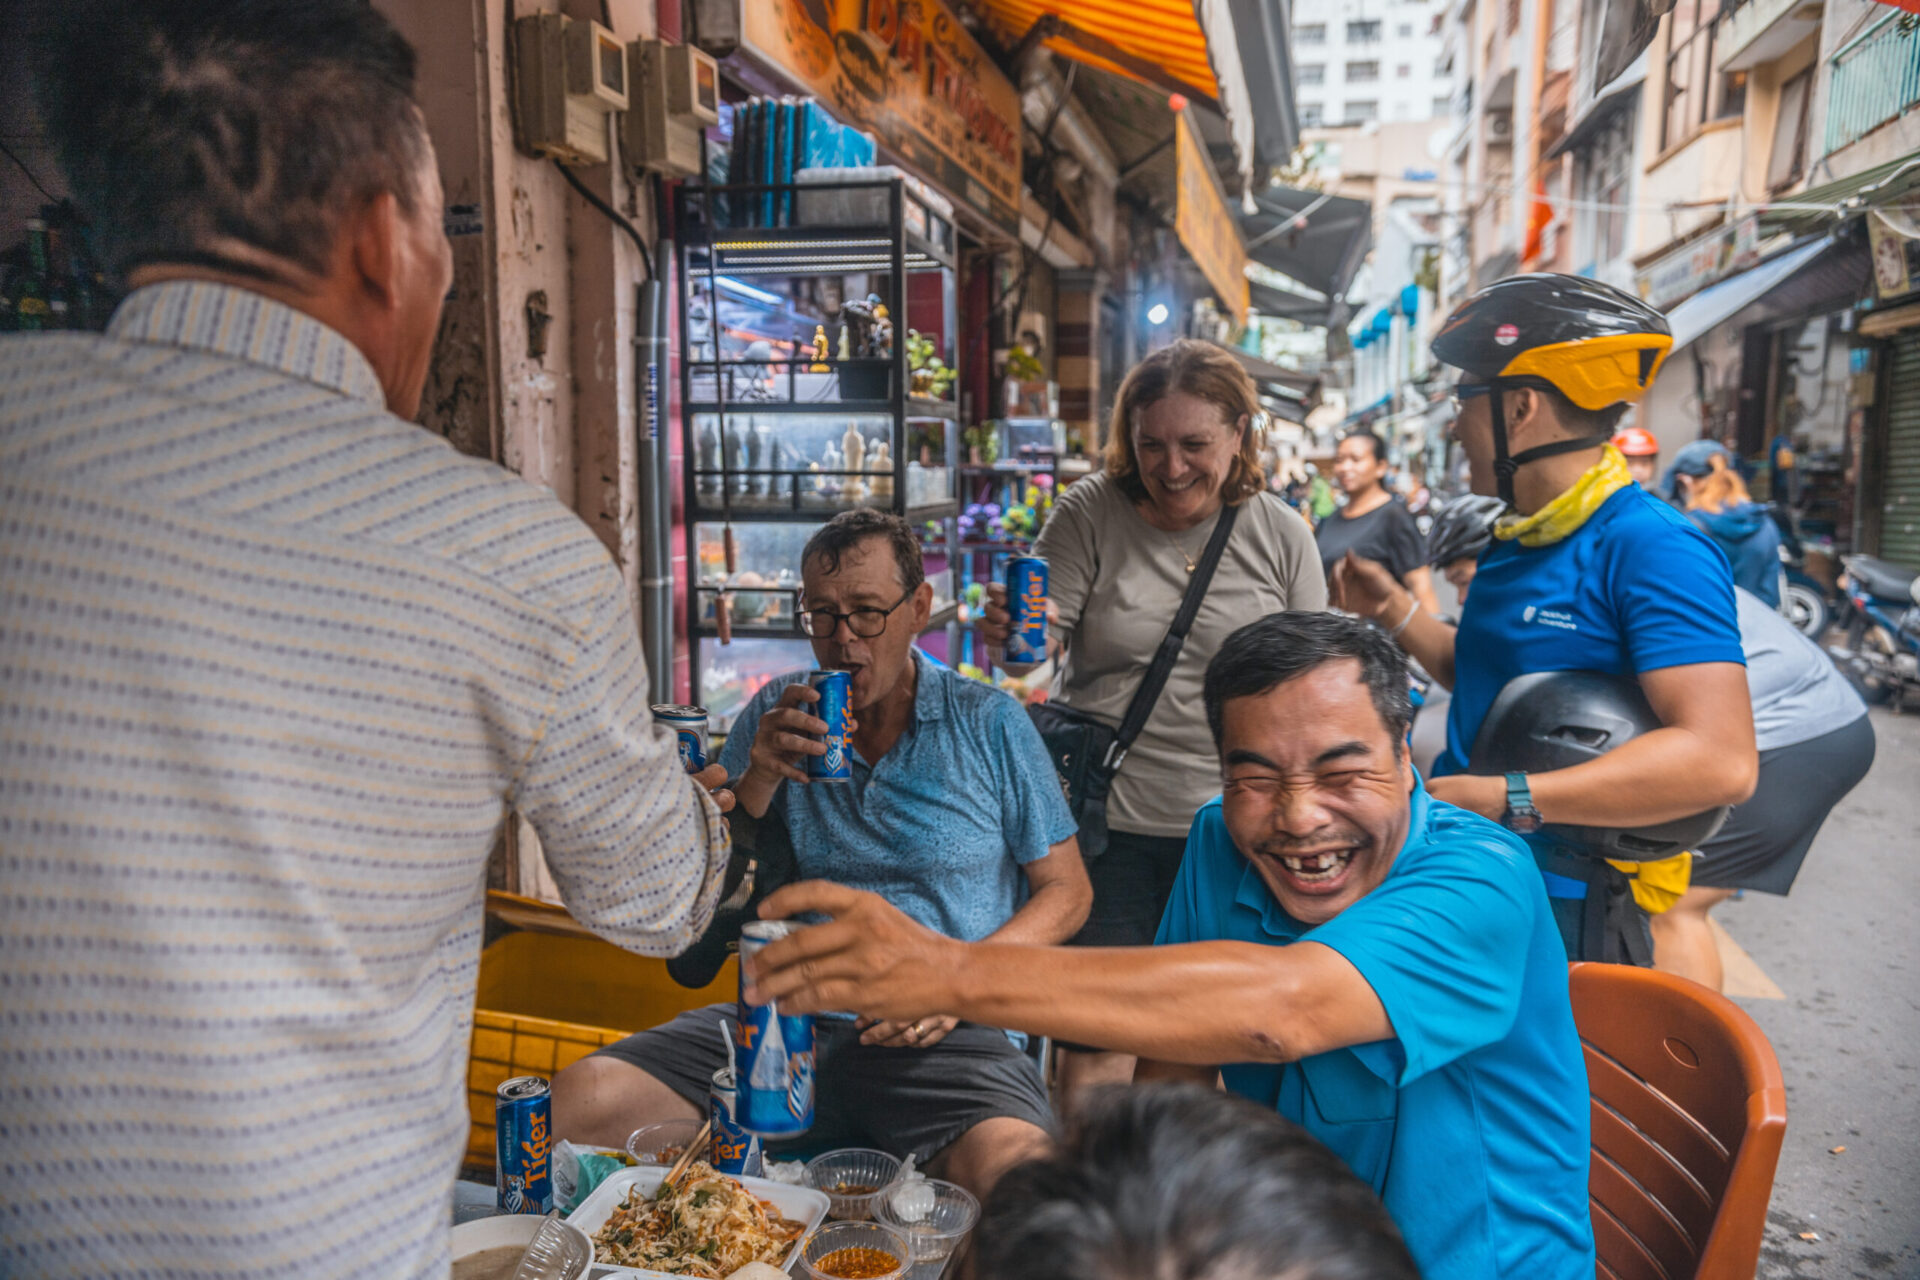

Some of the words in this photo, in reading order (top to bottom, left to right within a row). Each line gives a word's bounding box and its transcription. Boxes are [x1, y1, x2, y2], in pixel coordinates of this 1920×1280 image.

[1021, 571, 1047, 633] Tiger
[521, 1112, 551, 1189] Tiger
[711, 1135, 746, 1165] ger
